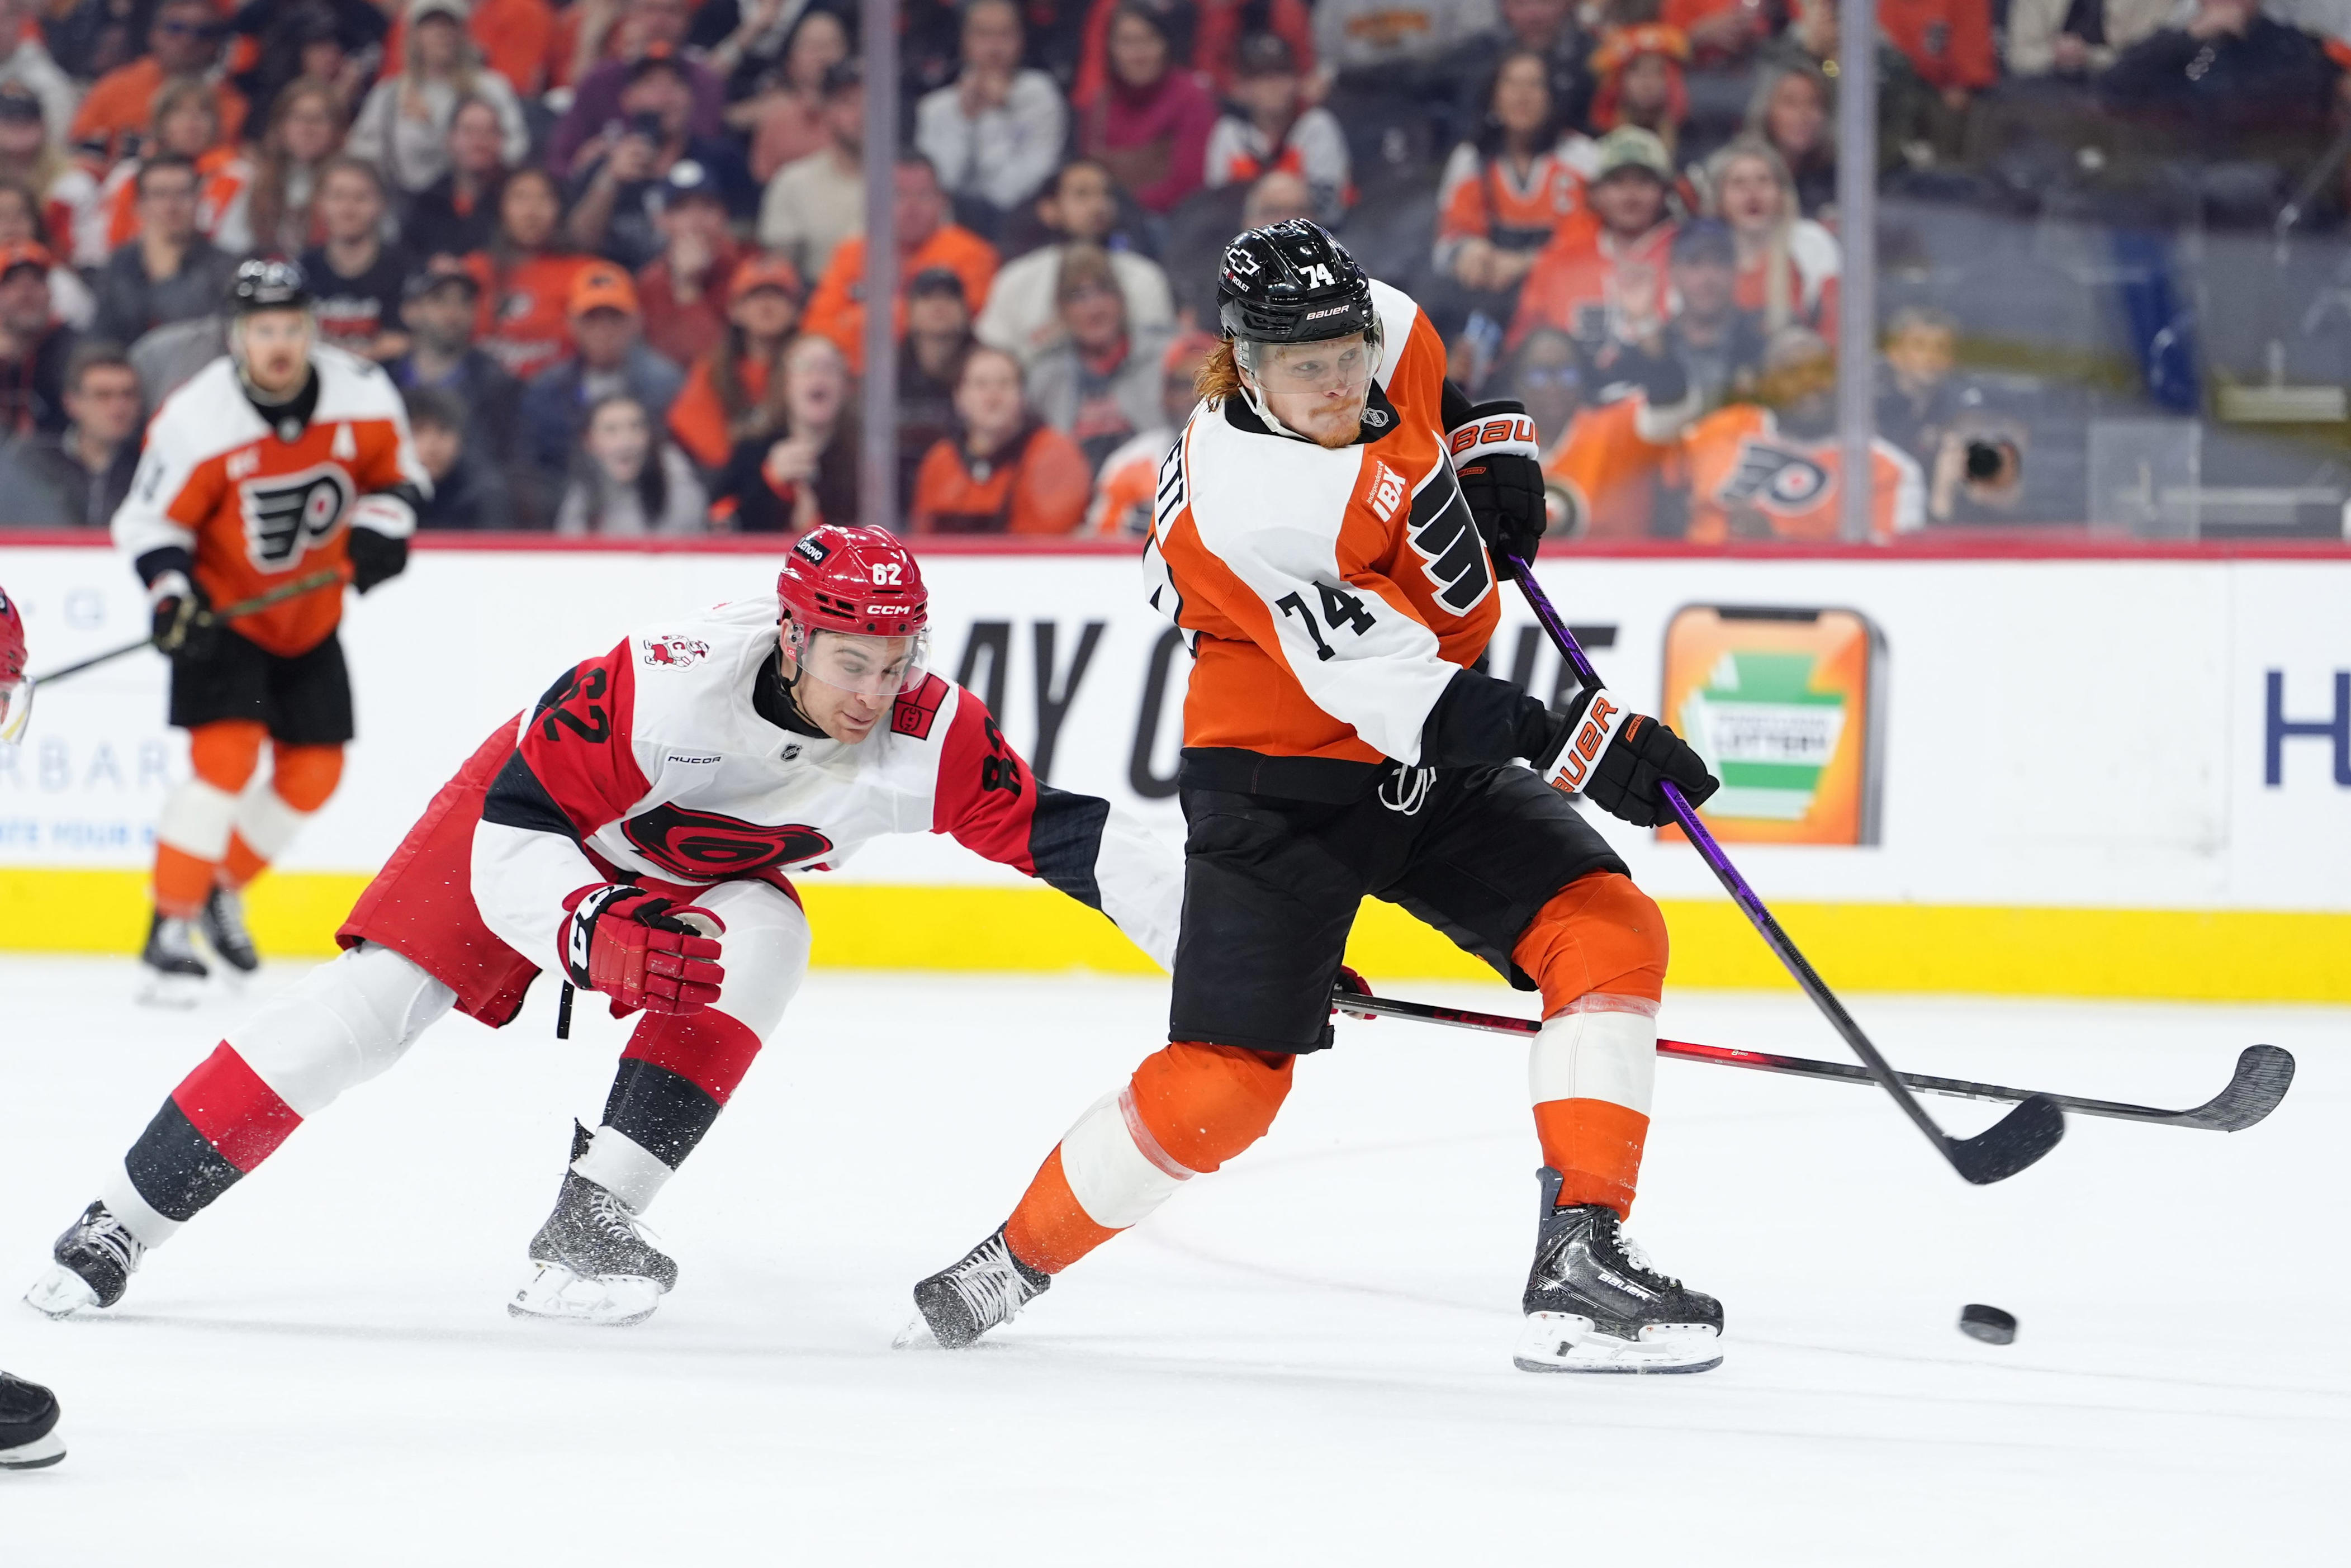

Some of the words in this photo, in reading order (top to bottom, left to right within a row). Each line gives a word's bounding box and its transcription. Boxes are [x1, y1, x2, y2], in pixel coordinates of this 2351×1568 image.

[1222, 266, 1250, 293] CHEVROLET
[1298, 263, 1336, 291] 74
[1306, 305, 1350, 320] BAUER
[1451, 420, 1540, 456] BAU
[1366, 465, 1383, 505] Independence
[1372, 465, 1406, 523] IBX
[797, 538, 823, 561] Lenovo
[871, 563, 903, 586] 62
[866, 605, 911, 615] CCM
[1275, 580, 1377, 662] 74
[543, 667, 610, 743] 62
[668, 756, 721, 764] NUCOR
[1598, 1272, 1650, 1301] BAUER
